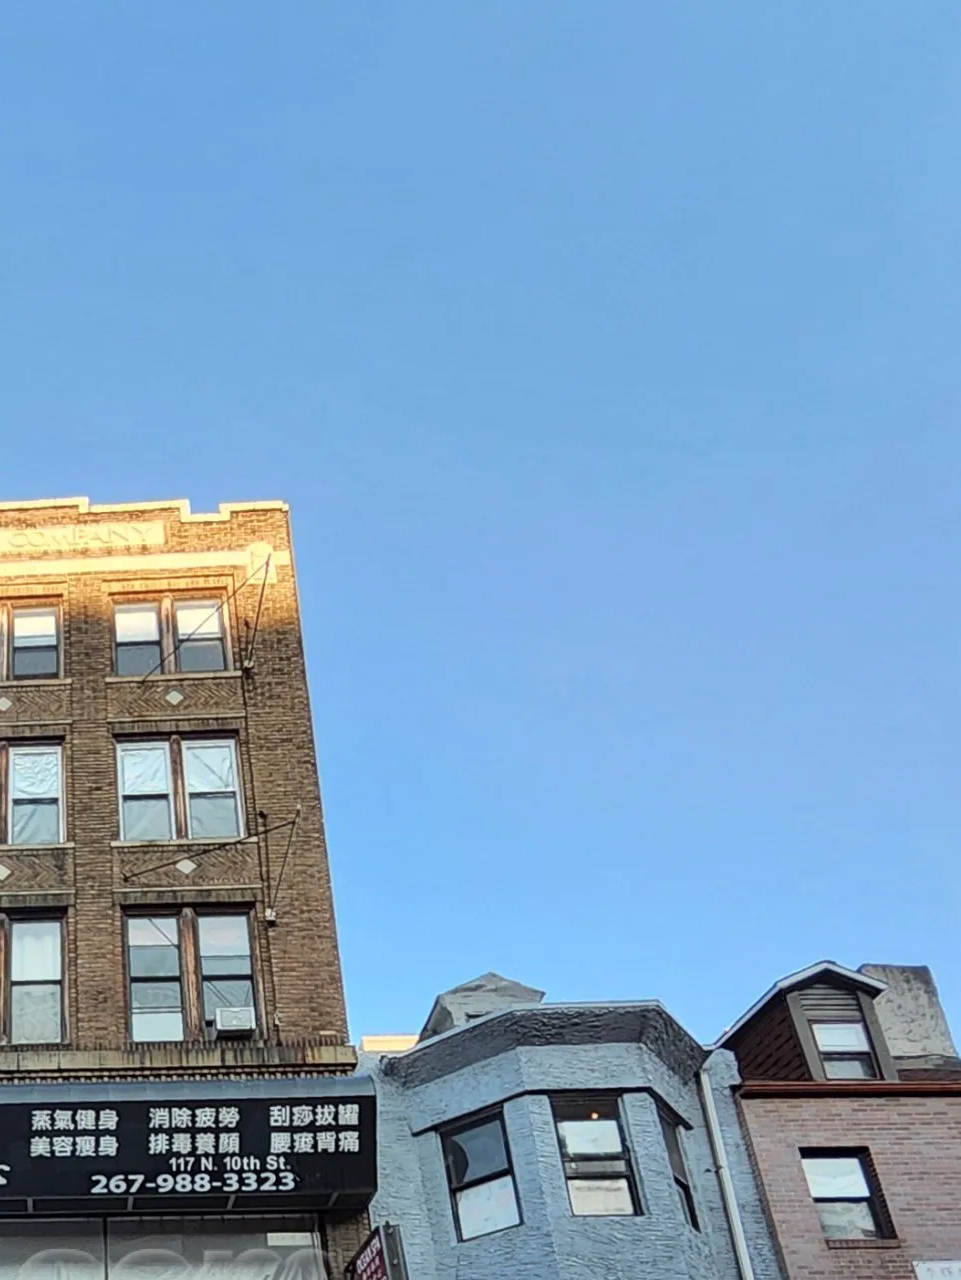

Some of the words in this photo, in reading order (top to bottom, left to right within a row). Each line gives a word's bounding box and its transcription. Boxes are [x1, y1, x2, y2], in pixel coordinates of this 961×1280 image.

[148, 1106, 240, 1129] 消除疲勞
[29, 1133, 119, 1158] 美容瘦身
[168, 1156, 193, 1172] 117
[200, 1156, 218, 1172] N.
[223, 1155, 261, 1171] 10th
[265, 1154, 292, 1171] St.
[90, 1172, 296, 1195] 267-988-3323
